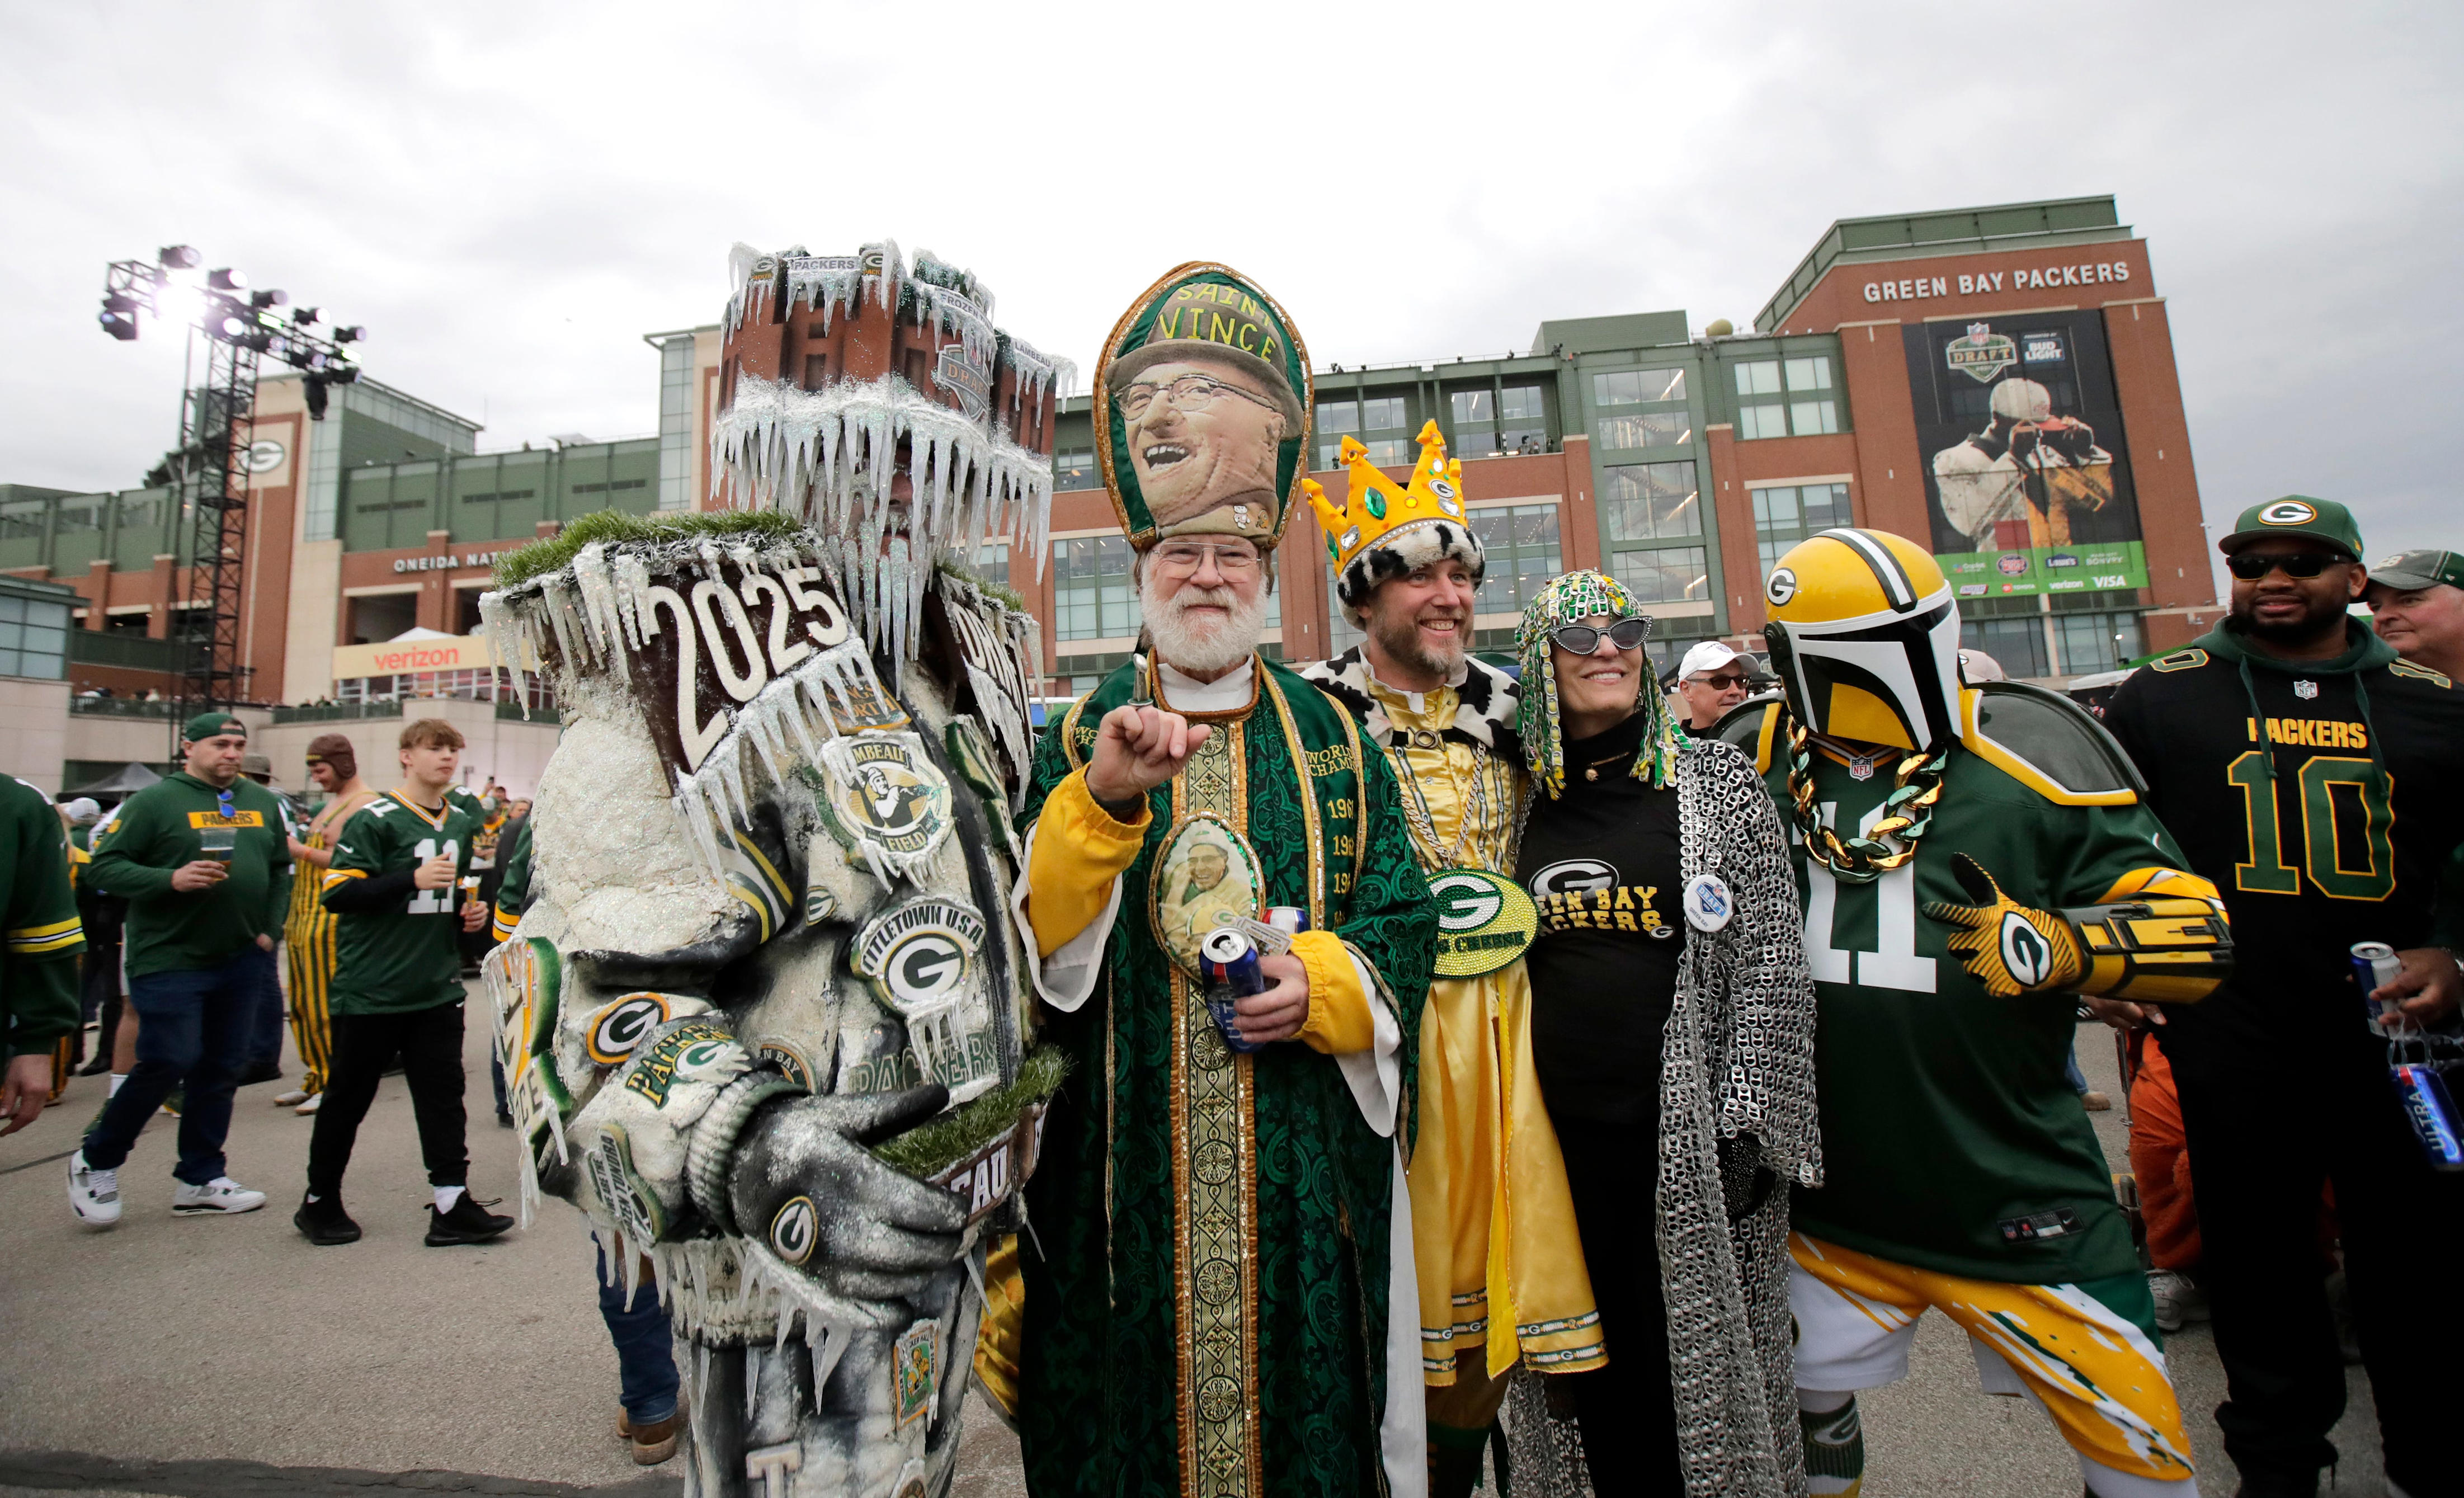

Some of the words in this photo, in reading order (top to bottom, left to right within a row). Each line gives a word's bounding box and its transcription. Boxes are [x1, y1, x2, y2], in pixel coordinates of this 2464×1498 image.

[794, 260, 855, 270] PACKERS
[1864, 276, 1947, 303] GREEN
[1958, 271, 2004, 295] BAY
[2014, 261, 2130, 290] PACKERS
[941, 294, 979, 318] FROZEN
[1177, 284, 1271, 326] SAINT
[1160, 308, 1276, 363] VINCE
[2029, 341, 2056, 350] BUD
[1015, 341, 1051, 367] LAMBEAU
[1953, 347, 2010, 362] DRAFT
[2025, 348, 2062, 360] LIGHT
[2259, 502, 2316, 525] G
[394, 555, 459, 572] ONEIDA
[467, 552, 498, 566] NAT
[1766, 568, 1796, 605] G
[2050, 580, 2084, 589] verizon
[2091, 575, 2127, 588] VISA
[374, 647, 459, 670] verizon
[648, 566, 849, 772] 2025
[852, 743, 906, 763] MBEAU
[2227, 750, 2396, 902] 10
[885, 830, 926, 852] FIELD
[408, 838, 459, 915] 11
[1534, 862, 1613, 901] G
[1534, 891, 1584, 917] EEN
[1595, 886, 1657, 910] BAY
[1698, 887, 1724, 913] DRAFT
[1793, 801, 1937, 993] 11
[1540, 910, 1662, 937] CKERS
[1650, 926, 1674, 939] G
[1455, 930, 1526, 951] CHEESE
[2000, 912, 2052, 986] G
[888, 937, 963, 1002] G
[593, 997, 662, 1058] G
[677, 1041, 728, 1074] G
[775, 1051, 800, 1074] BAY
[2409, 1090, 2447, 1151] ULTRA
[600, 1135, 628, 1195] TUNDRA
[775, 1203, 813, 1261] G
